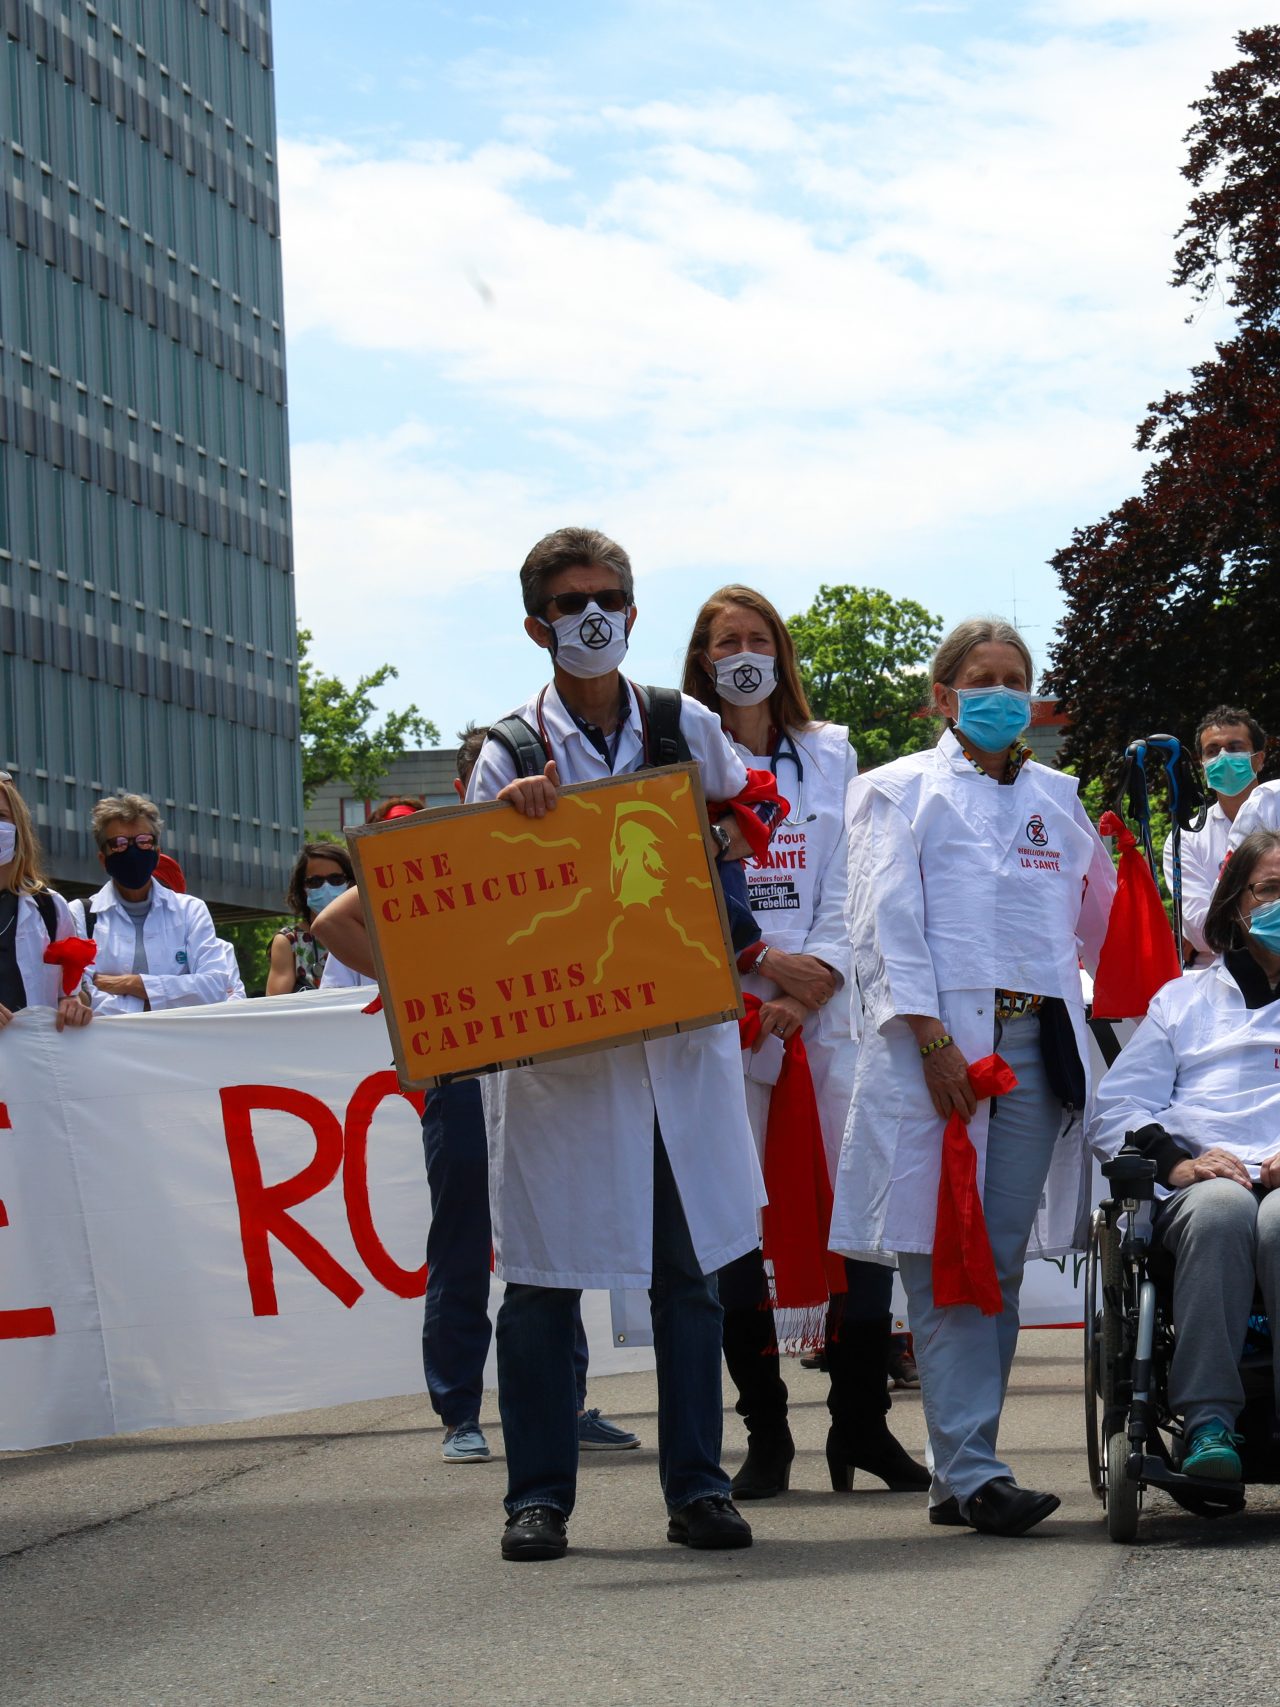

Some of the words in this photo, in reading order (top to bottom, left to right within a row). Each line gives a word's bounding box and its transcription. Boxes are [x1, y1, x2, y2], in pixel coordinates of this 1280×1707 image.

[778, 833, 806, 845] POUR
[1018, 848, 1045, 856] REBELLION
[1046, 851, 1060, 859] POUR
[373, 853, 453, 890] UNE
[1020, 858, 1032, 868] LA
[1033, 860, 1060, 872] SANTÉ
[748, 875, 773, 883] Doctors
[381, 861, 579, 923] CANICULE
[758, 897, 798, 909] rebellion
[404, 986, 478, 1024] DES
[496, 962, 587, 1003] VIES
[411, 981, 658, 1056] CAPITULENT
